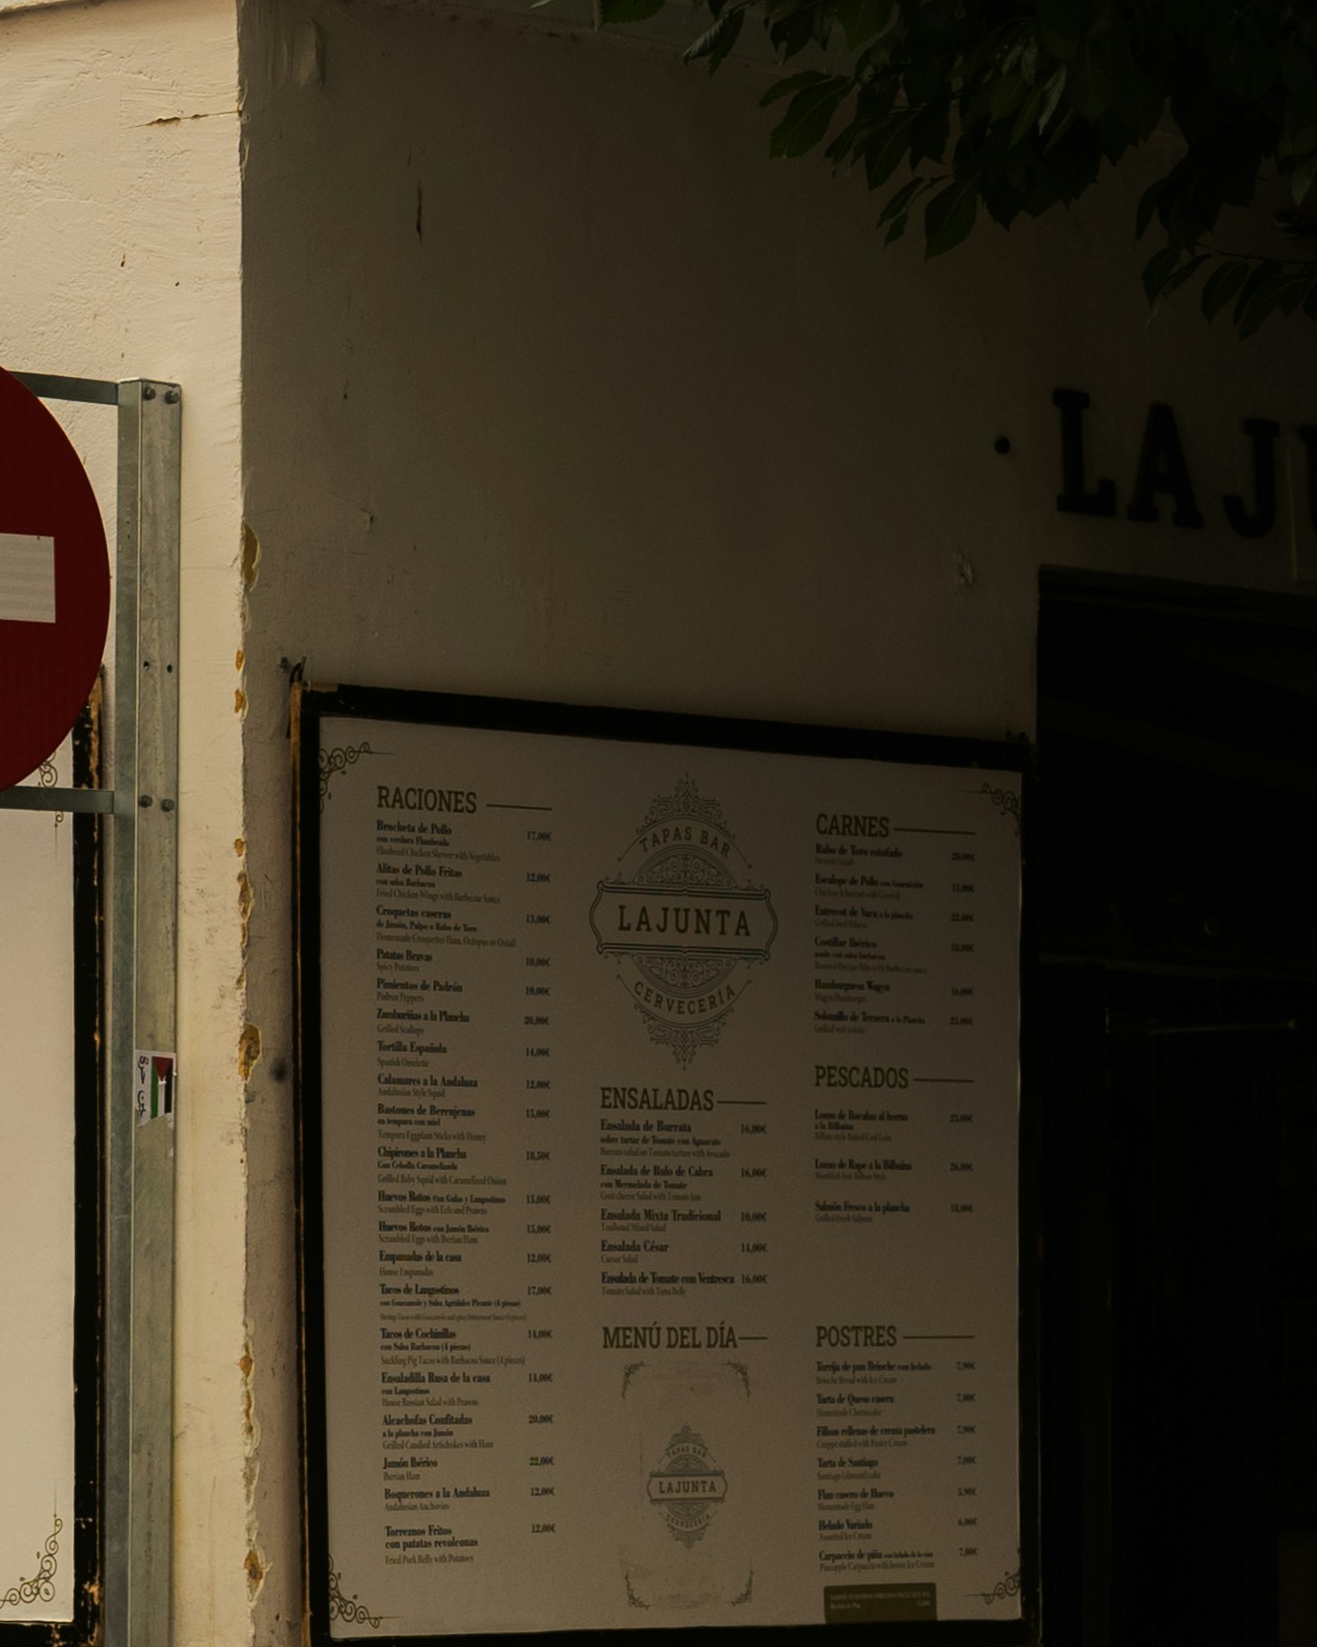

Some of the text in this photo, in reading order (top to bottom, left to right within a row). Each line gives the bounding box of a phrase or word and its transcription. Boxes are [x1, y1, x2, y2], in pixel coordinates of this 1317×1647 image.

[377, 785, 476, 813] RACIONES
[816, 813, 889, 838] CARNES
[639, 827, 730, 858] TAPAS BAR
[618, 905, 750, 936] LAJUNTA
[633, 980, 736, 1015] CERVECERÍA
[815, 1065, 908, 1088] PESCADOS
[600, 1086, 717, 1111] ENSALADAS
[602, 1321, 738, 1348] MENÚ DEL DÍA
[816, 1325, 896, 1347] POSTRES
[659, 1480, 716, 1493] LAJUNTA
